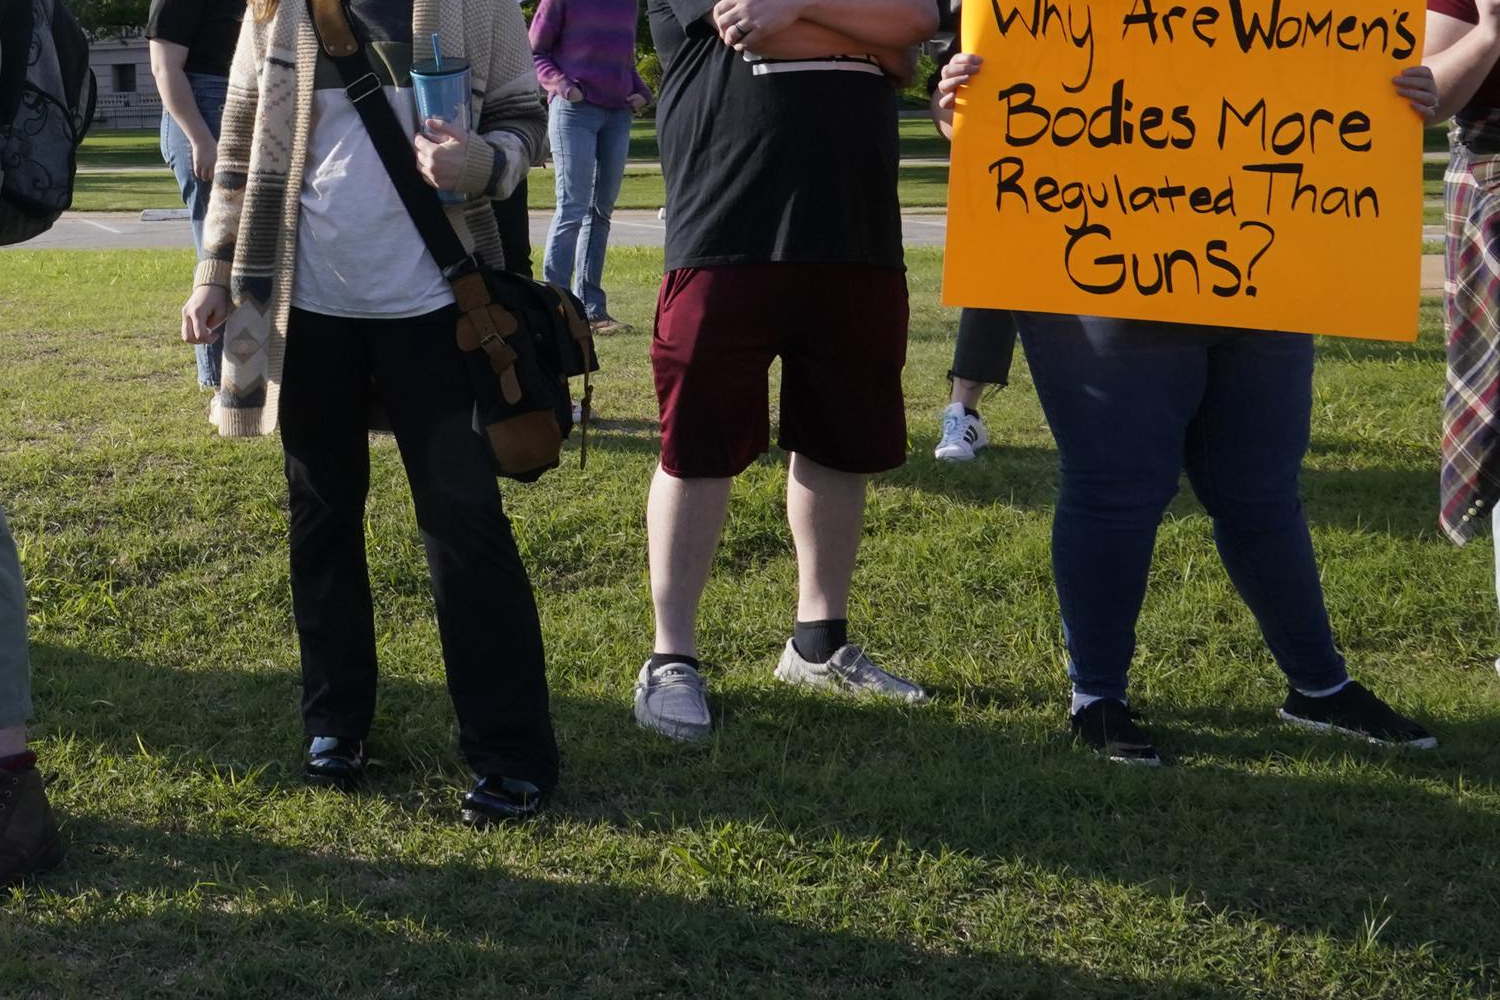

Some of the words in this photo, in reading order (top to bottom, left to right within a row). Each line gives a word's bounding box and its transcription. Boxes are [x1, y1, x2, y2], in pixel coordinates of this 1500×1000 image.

[999, 80, 1195, 149] Bodies
[1218, 97, 1372, 155] More
[989, 156, 1236, 230] Regulated
[1242, 163, 1379, 218] Than
[1064, 221, 1275, 298] Guns?
